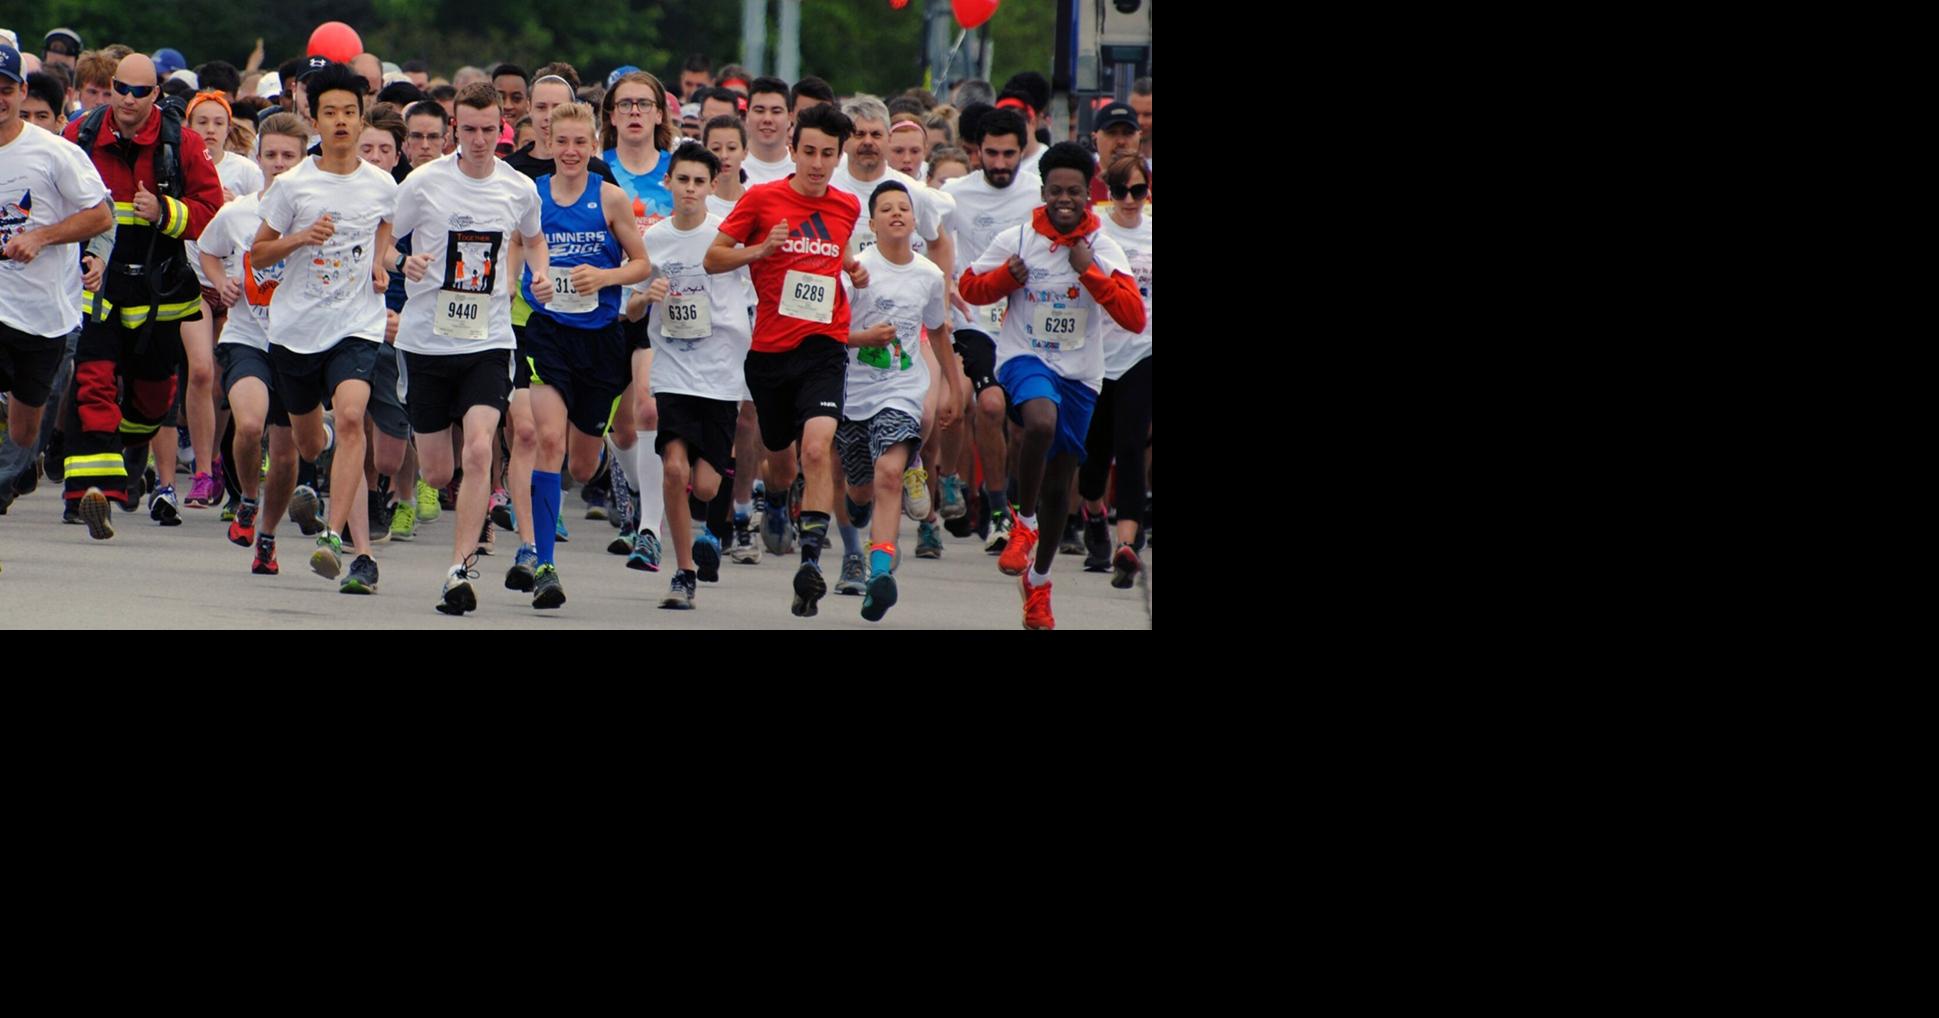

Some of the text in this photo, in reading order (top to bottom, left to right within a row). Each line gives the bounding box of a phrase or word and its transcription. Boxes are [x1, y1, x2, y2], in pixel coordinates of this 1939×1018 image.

[781, 236, 841, 258] adidas
[794, 282, 825, 303] 6289
[448, 302, 478, 320] 9440
[669, 303, 697, 321] 6336
[1045, 317, 1076, 334] 6293
